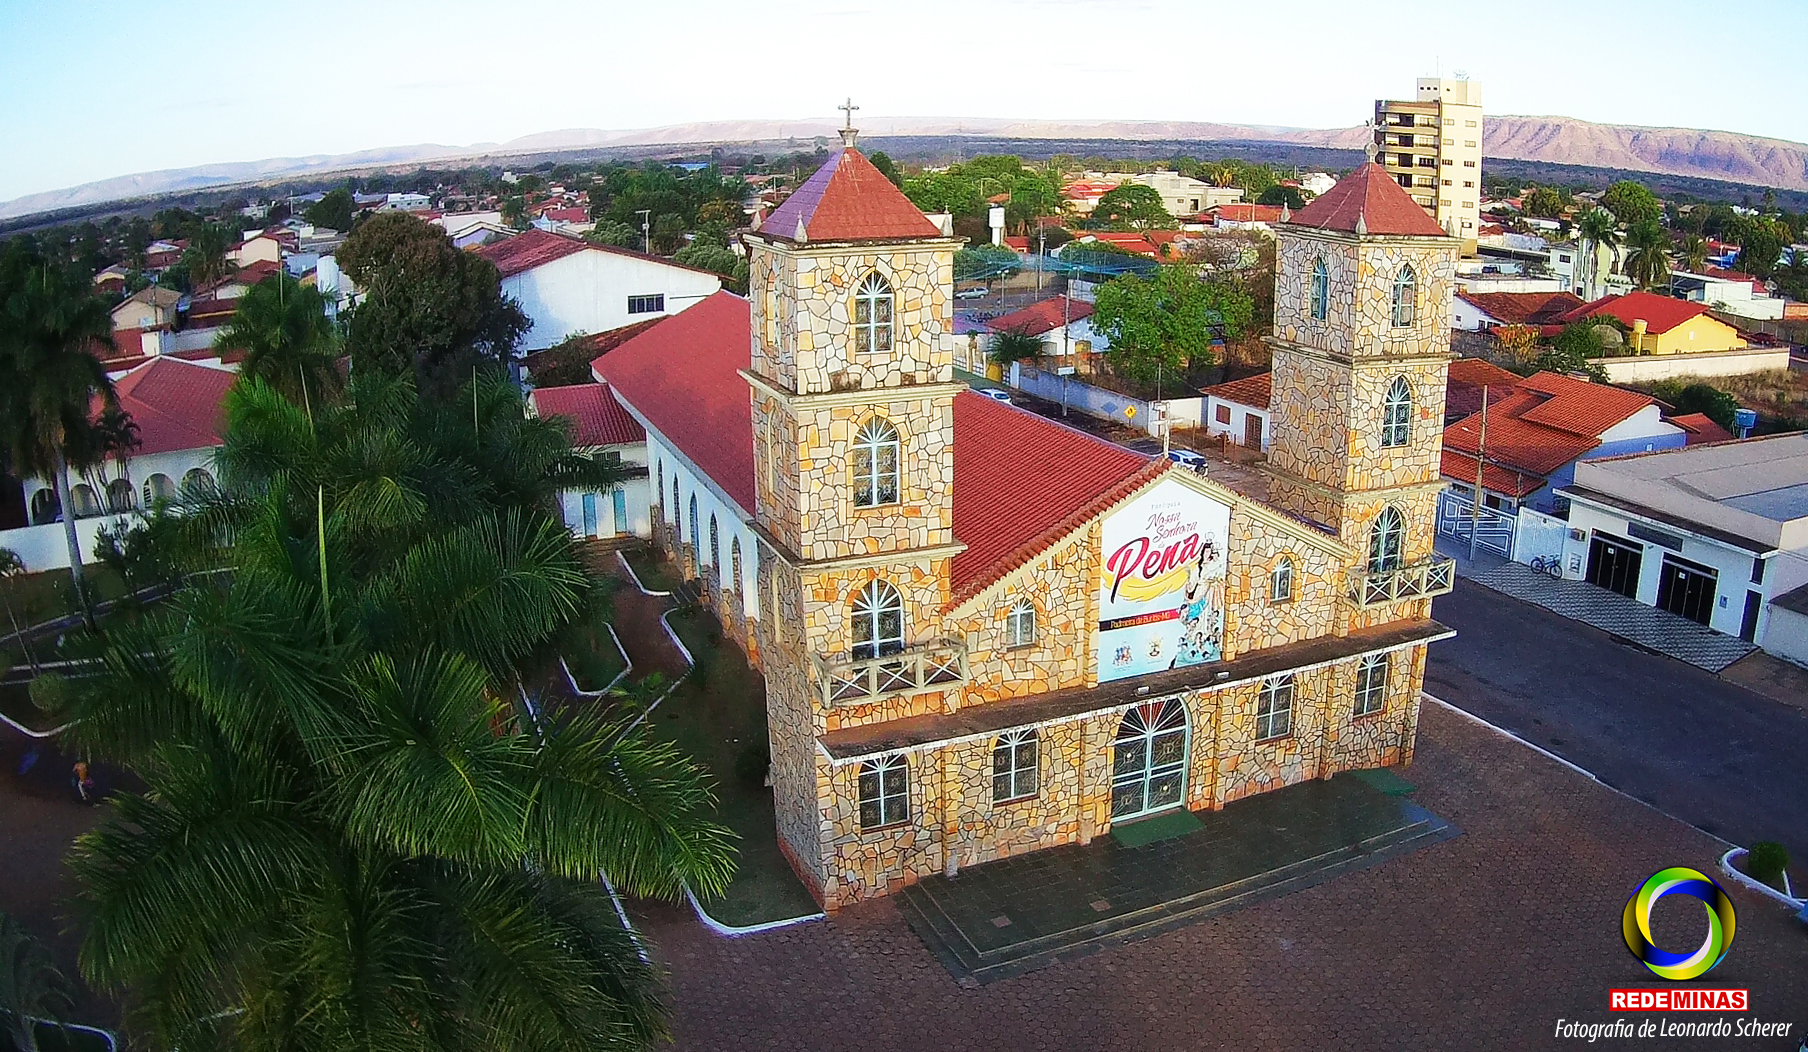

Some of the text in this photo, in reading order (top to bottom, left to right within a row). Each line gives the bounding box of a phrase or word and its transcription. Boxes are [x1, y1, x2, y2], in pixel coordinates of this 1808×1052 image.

[1145, 511, 1181, 530] Nossa
[1152, 521, 1198, 543] Senhora
[1107, 533, 1200, 604] Pena
